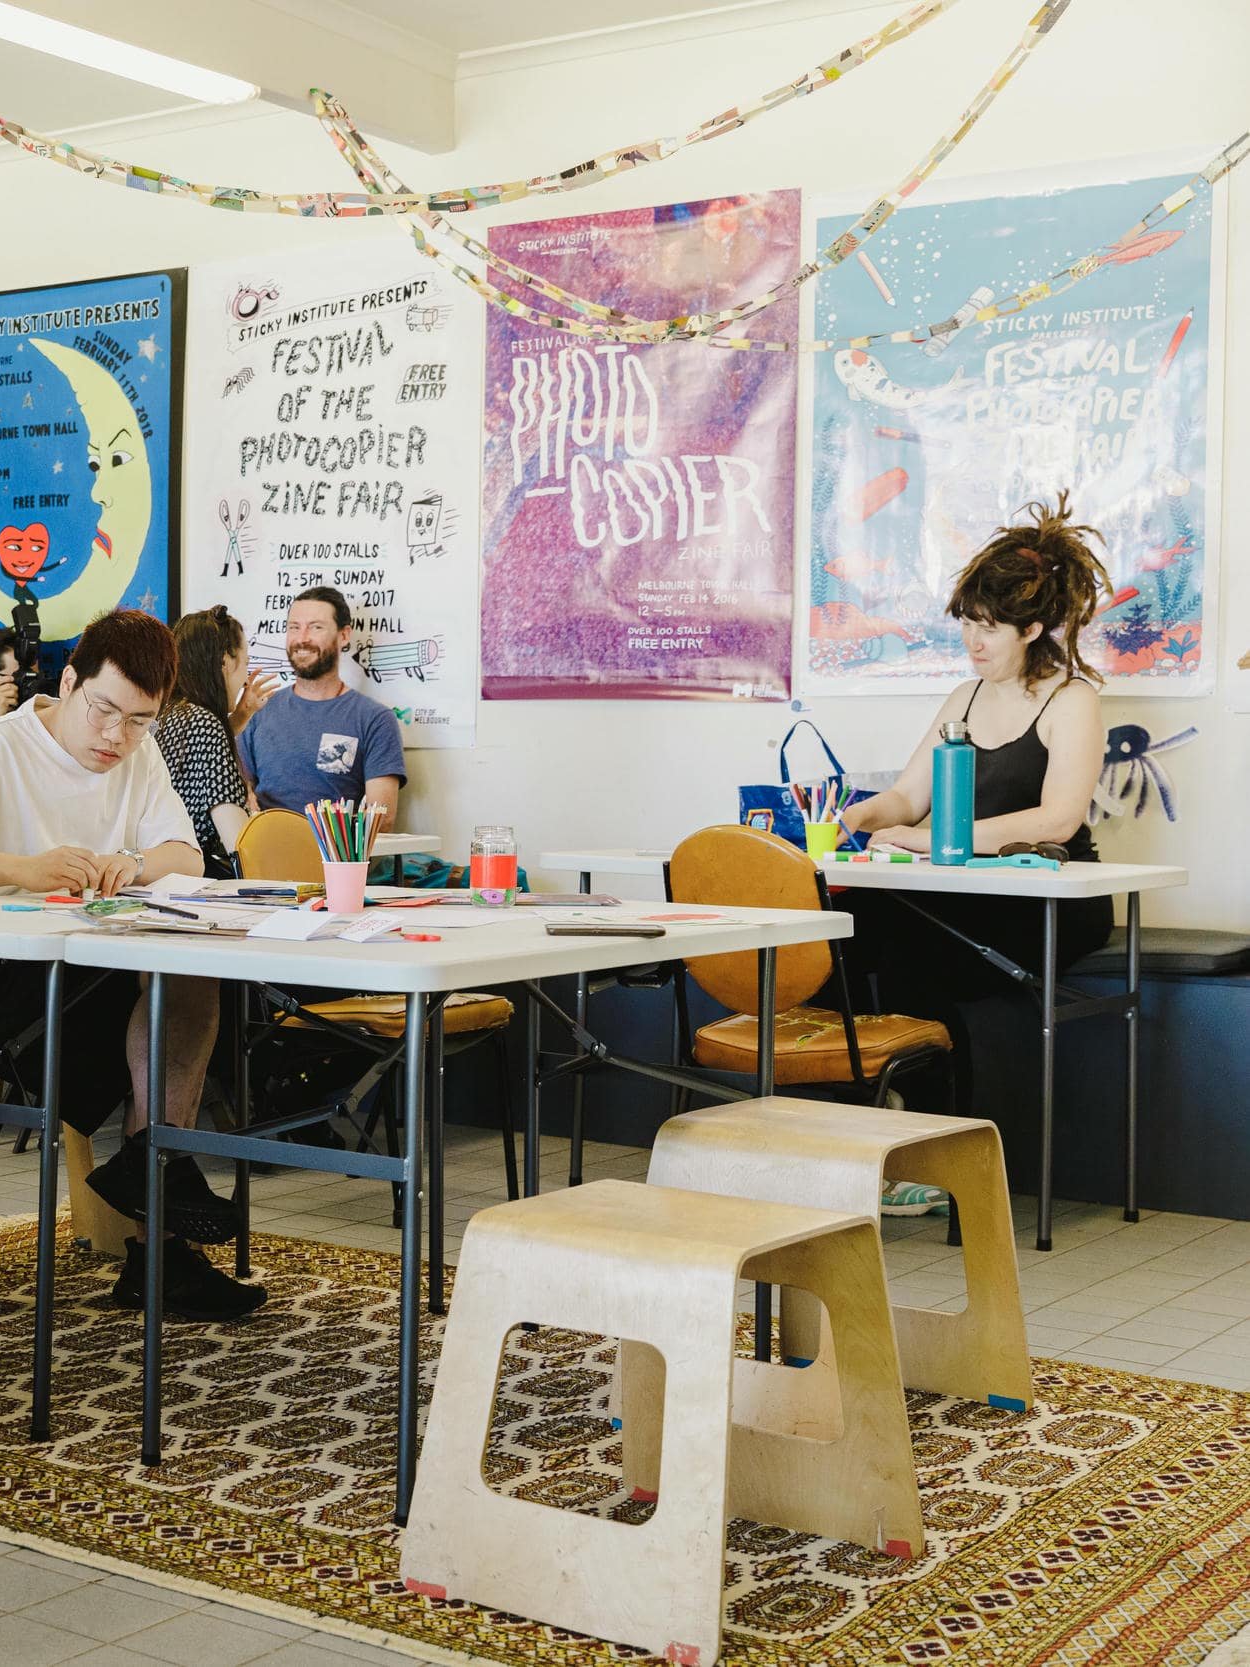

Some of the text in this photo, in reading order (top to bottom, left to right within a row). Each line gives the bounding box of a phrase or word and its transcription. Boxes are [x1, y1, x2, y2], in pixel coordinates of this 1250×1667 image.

[517, 231, 611, 252] STICKY INSTITUTE
[8, 309, 80, 334] INSTITUTE
[85, 299, 159, 325] PRESENTS
[238, 281, 428, 342] STICKY INSTITUTE PRESENTS
[983, 304, 1156, 335] STICKY INSTITUTE
[93, 331, 132, 364] SUNDAY
[271, 320, 394, 376] FESTIVAL
[511, 336, 570, 353] FESTIVAL
[984, 338, 1150, 386] FESTIVAL
[407, 364, 448, 381] FREE
[73, 336, 153, 439] FEBRUARY 11TH 2018
[400, 383, 448, 401] ENTRY
[277, 385, 374, 422] OF THE
[509, 344, 658, 487] PHOTO
[23, 424, 50, 438] TOWN
[54, 422, 78, 435] HALL
[239, 424, 427, 476] PHOTOCOPIER
[13, 494, 70, 509] FREE ENTRY
[262, 480, 403, 520] ZINE FAIR
[279, 543, 379, 560] OVER 100 STALLS
[334, 570, 385, 585] SUNDAY
[638, 580, 694, 590] MELBOURNE
[362, 589, 395, 607] 2017
[638, 593, 673, 602] SUNDAY
[679, 594, 695, 603] FEB
[370, 617, 404, 633] HALL
[628, 626, 712, 635] OVER 100 STALLS
[628, 639, 704, 649] FREE ENTRY
